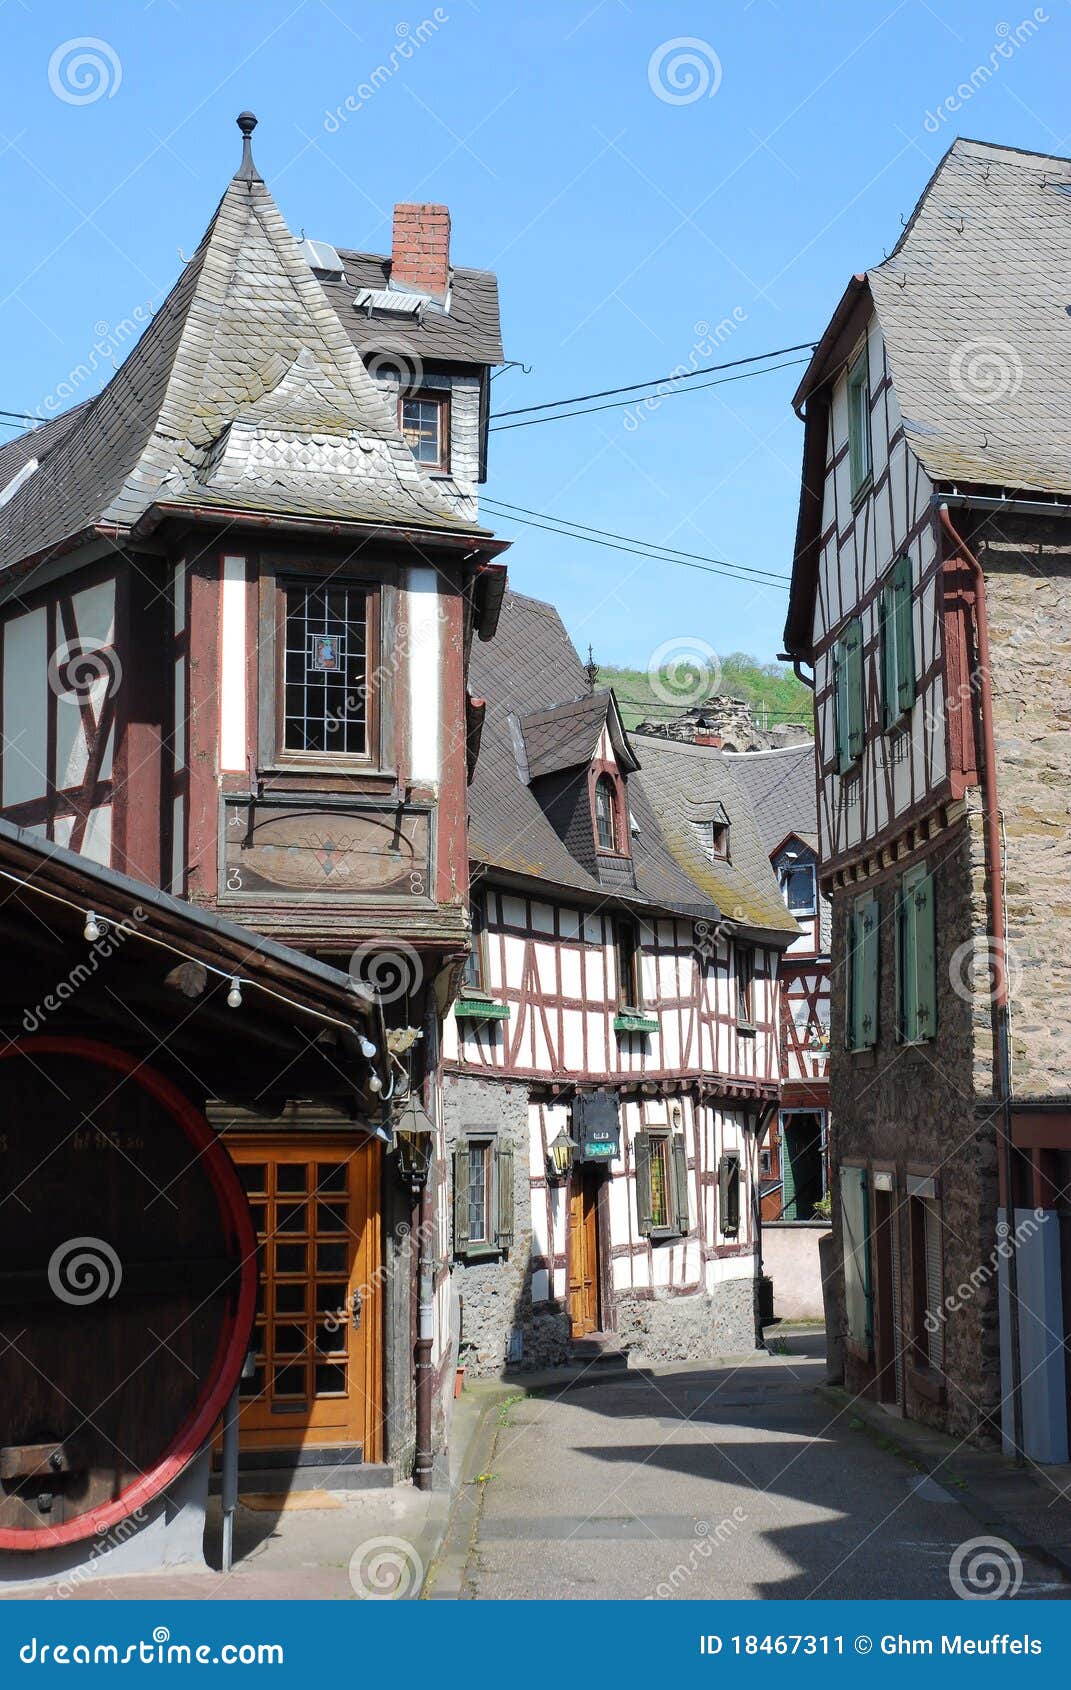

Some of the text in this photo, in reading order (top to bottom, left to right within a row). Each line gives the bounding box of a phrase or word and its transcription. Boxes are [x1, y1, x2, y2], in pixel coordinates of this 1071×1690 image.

[405, 817, 419, 839] 7
[227, 868, 424, 895] 3 8
